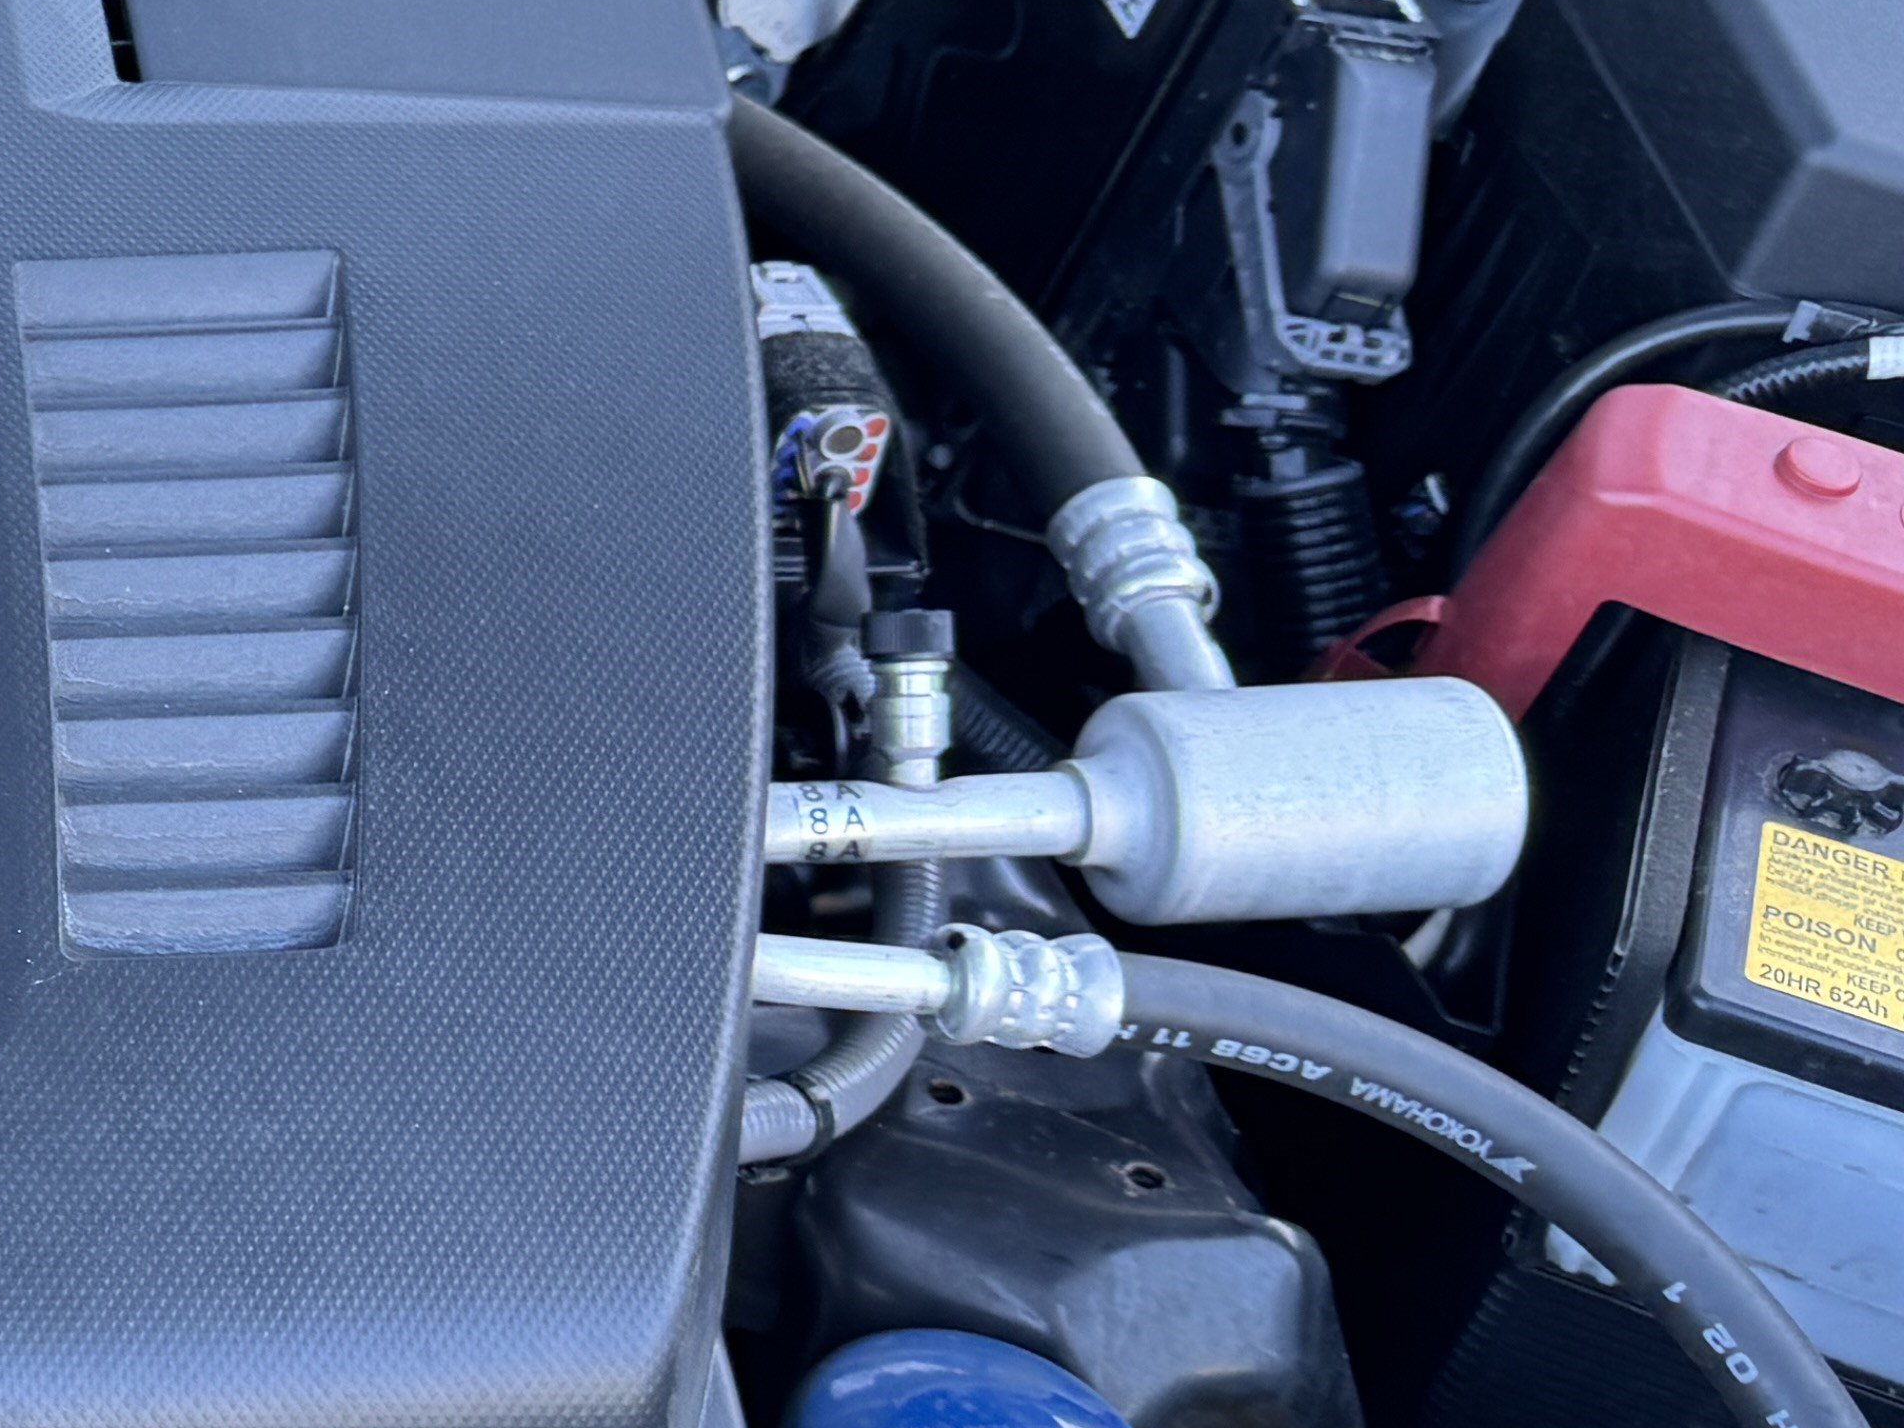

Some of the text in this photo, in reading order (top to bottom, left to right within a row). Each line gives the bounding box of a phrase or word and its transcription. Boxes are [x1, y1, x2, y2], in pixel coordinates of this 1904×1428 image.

[809, 805, 866, 835] 8 A
[1772, 829, 1891, 880] DANGER
[1762, 904, 1878, 954] POISON
[1853, 913, 1898, 937] KEEP
[1758, 962, 1822, 998] 20HR
[1828, 985, 1889, 1020] 62Ah
[1846, 972, 1892, 997] KEEP
[1349, 1075, 1494, 1161] YOKOHAMA
